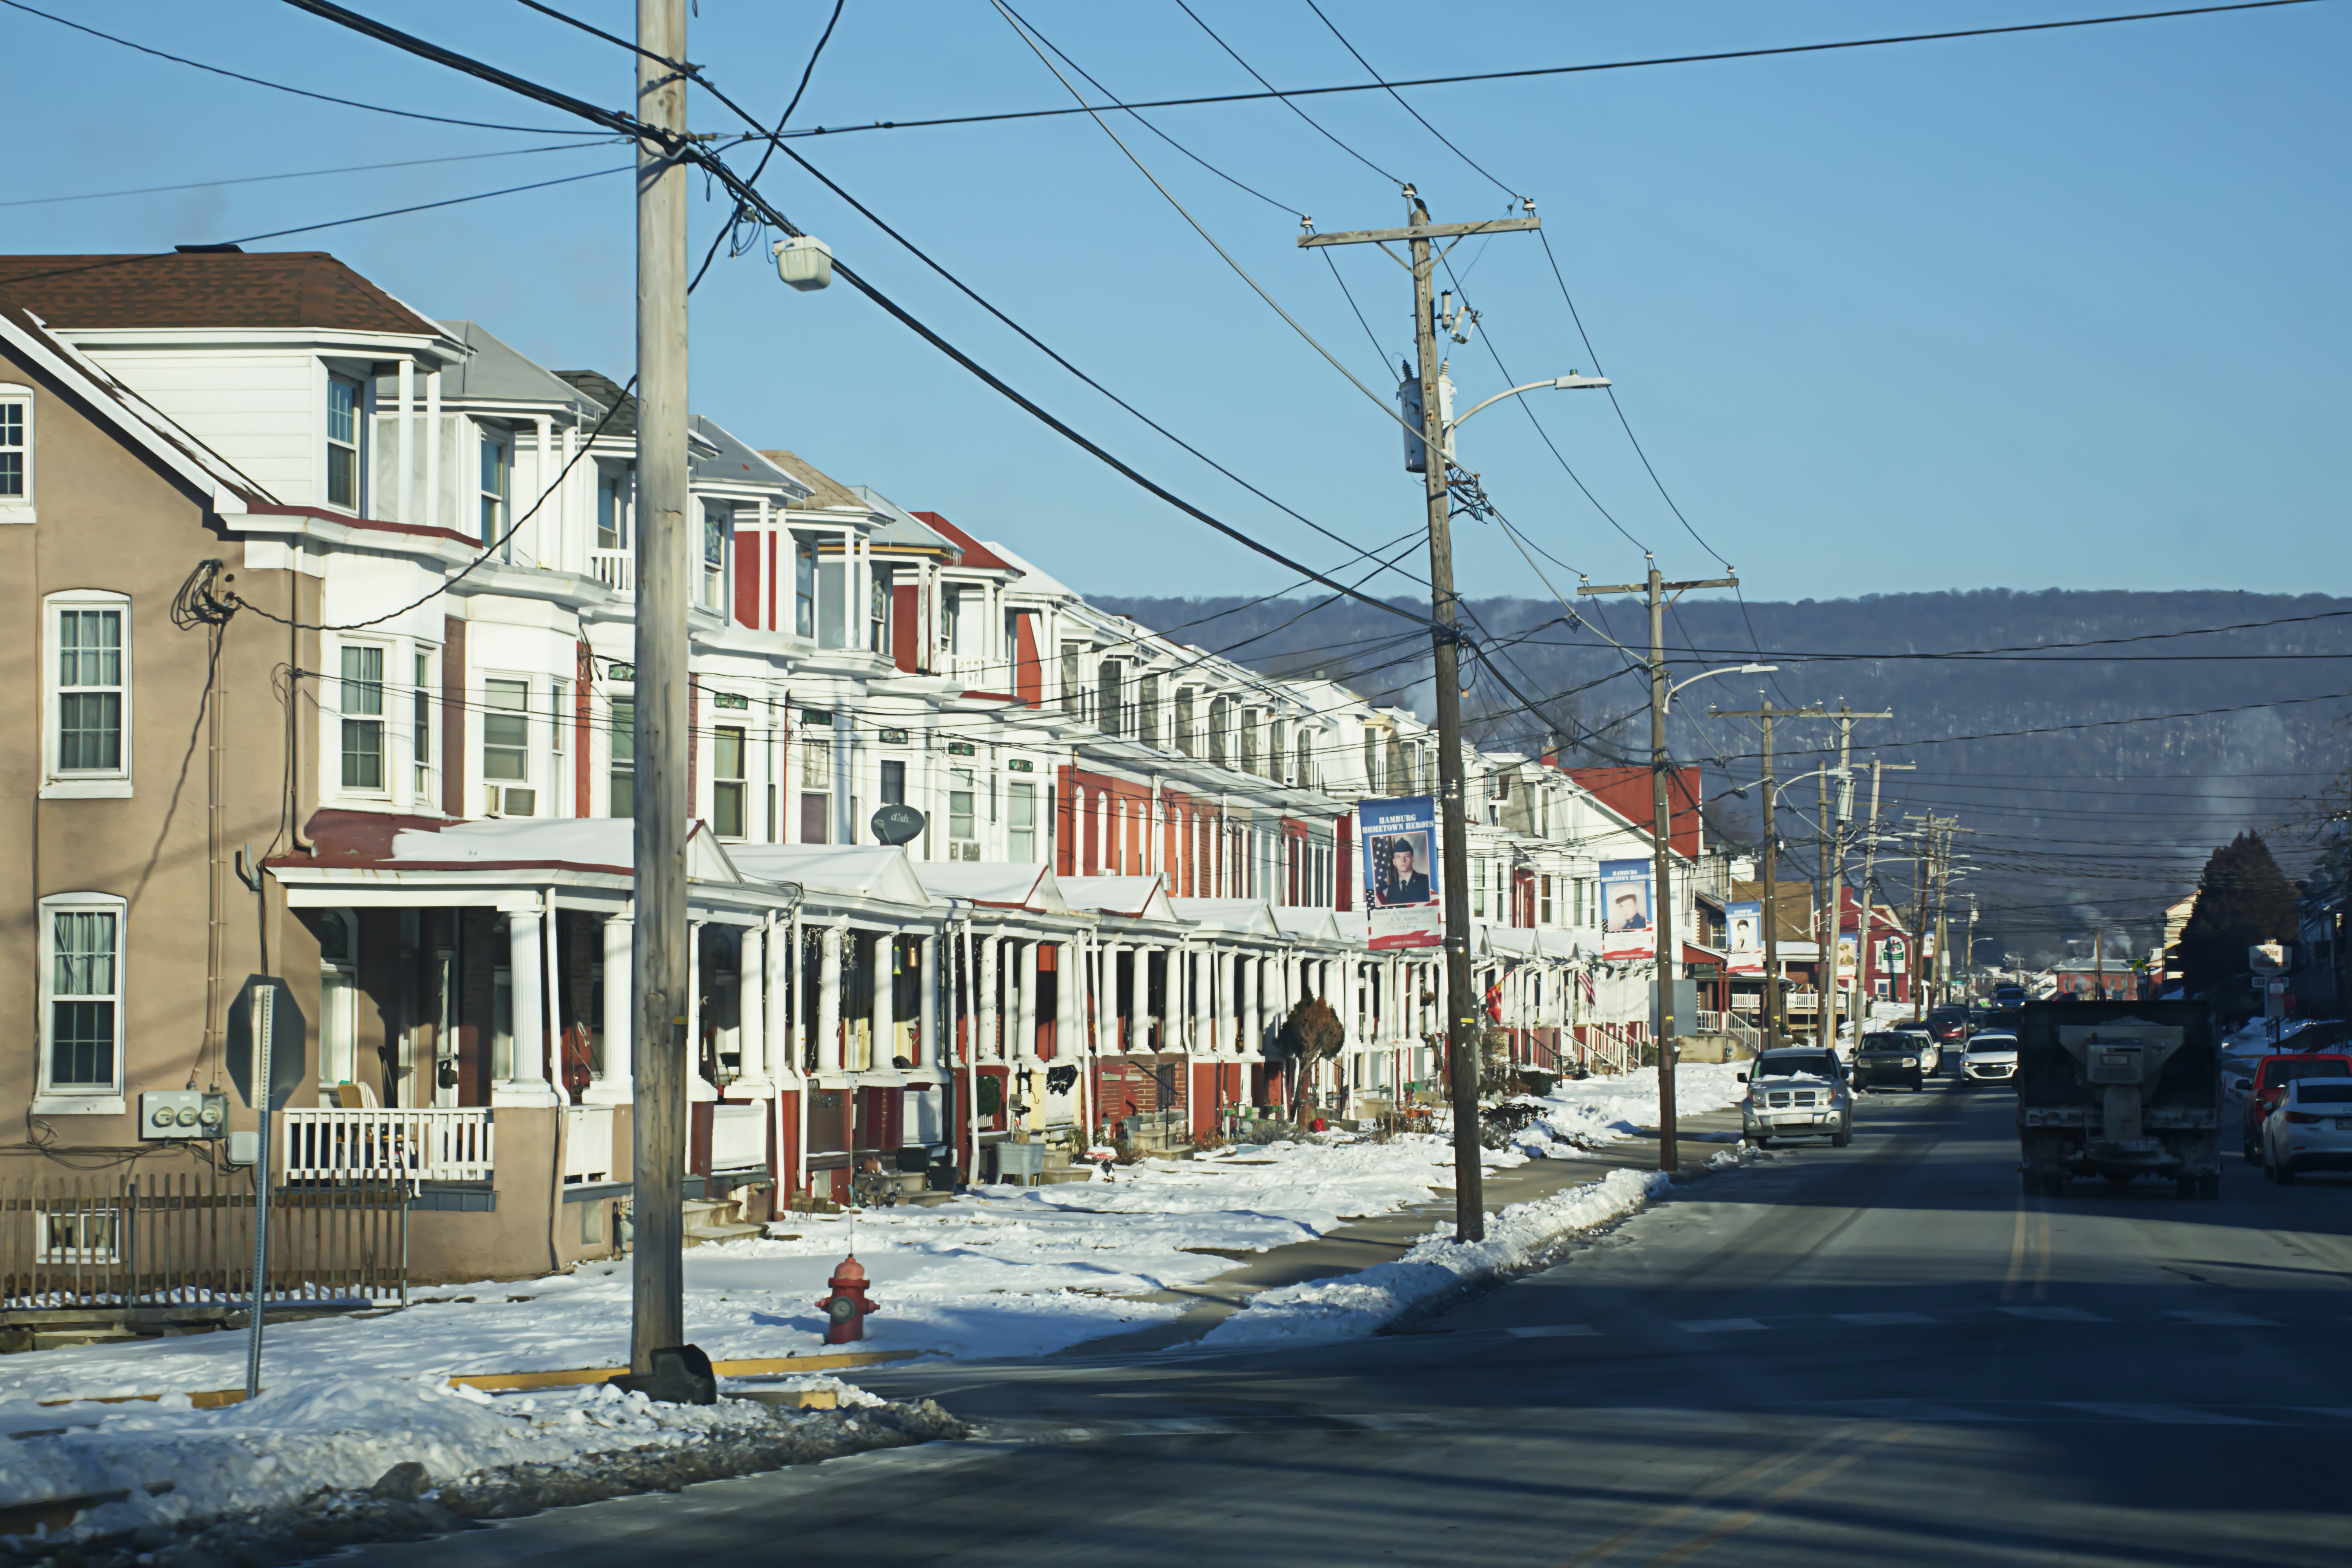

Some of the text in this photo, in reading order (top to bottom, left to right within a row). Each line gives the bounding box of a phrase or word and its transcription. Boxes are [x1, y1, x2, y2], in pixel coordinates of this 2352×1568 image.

[890, 813, 909, 822] dish
[1379, 814, 1416, 824] HAMBURG
[1362, 820, 1434, 833] HOMETOWN HEROES
[2262, 948, 2279, 956] Die
